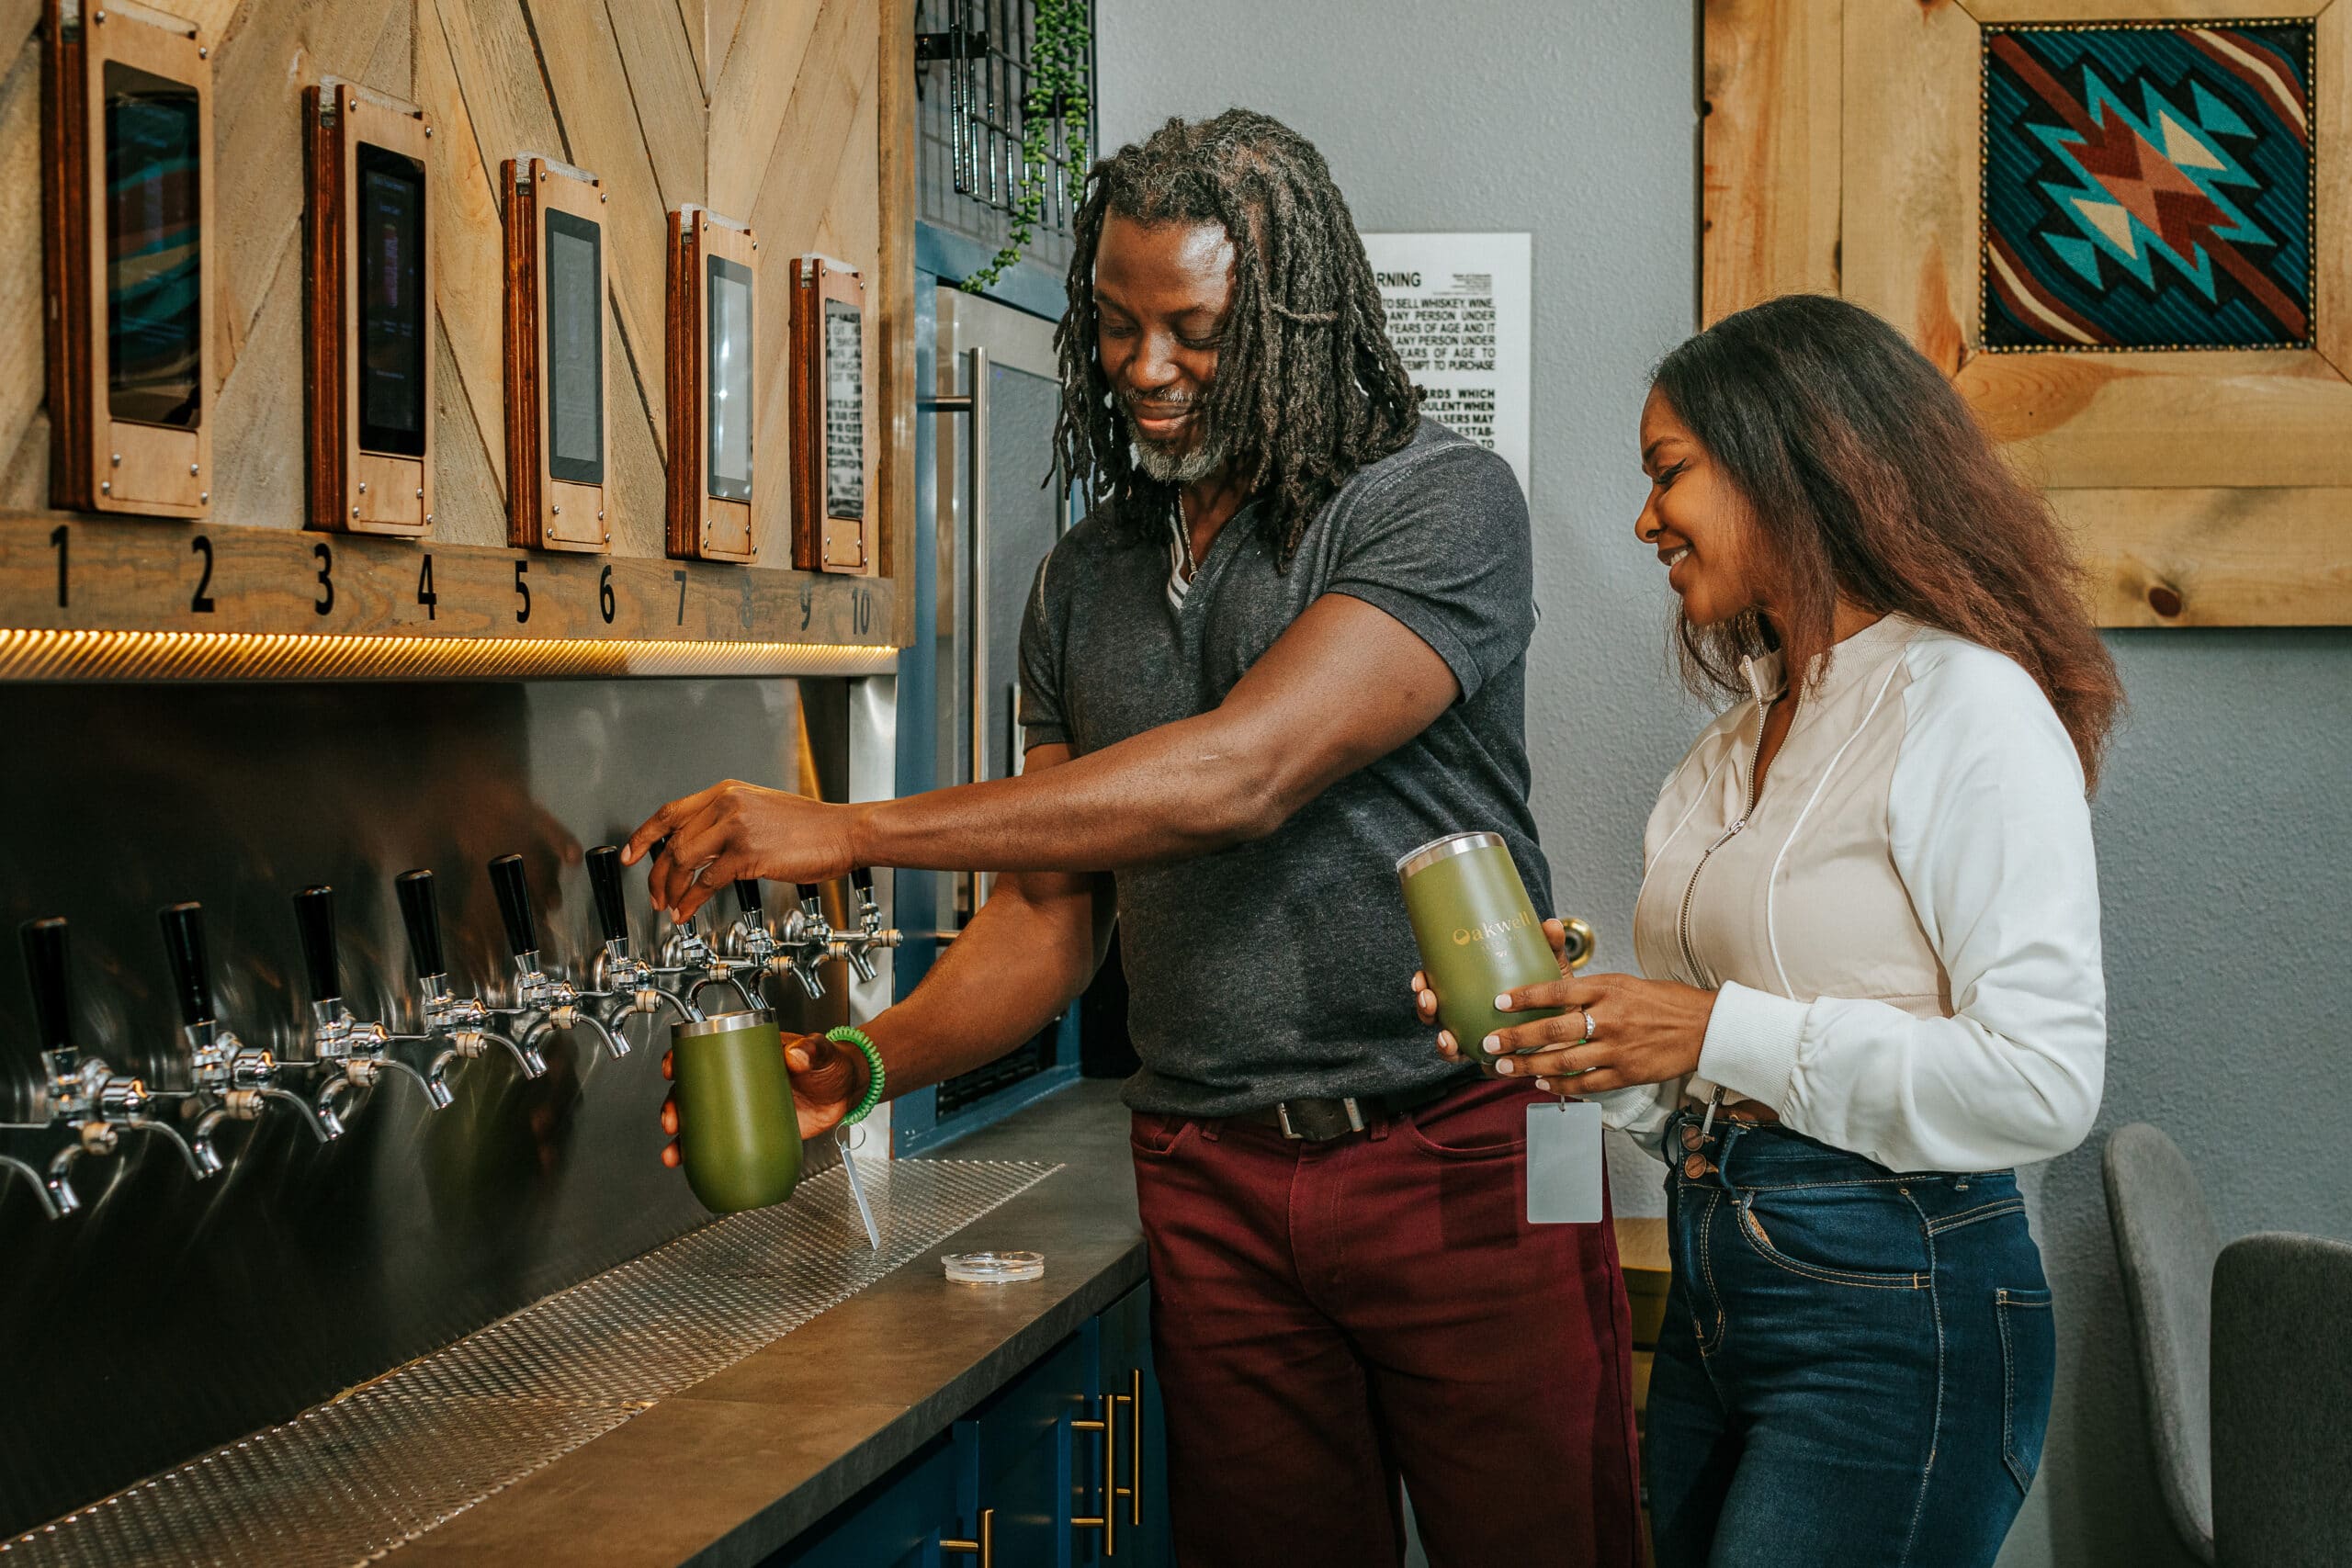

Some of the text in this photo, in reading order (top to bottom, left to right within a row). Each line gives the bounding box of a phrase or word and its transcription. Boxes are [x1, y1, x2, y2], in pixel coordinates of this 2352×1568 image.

[1376, 273, 1421, 288] RNING
[1383, 299, 1396, 309] TO
[1396, 299, 1419, 309] SELL
[1389, 310, 1496, 321] ANY PERSON UNDER
[1389, 323, 1496, 333] YEARS OF AGE AND IT
[1396, 336, 1415, 345] ANY
[1419, 336, 1459, 345] PERSON
[1461, 336, 1496, 345] UNDER
[1433, 348, 1447, 358] OF
[1453, 348, 1476, 357] AGE
[1483, 348, 1496, 357] TO
[1403, 360, 1496, 371] TEMPT TO PURCHASE
[1458, 389, 1496, 399] WHICH
[1419, 402, 1495, 411] DULENT WHEN
[1437, 414, 1495, 423] ASERS MAY
[1481, 440, 1495, 449] TO
[51, 525, 870, 635] 1 2 3 4 5 6 7 8 9 10
[1453, 910, 1531, 945] Oakwell
